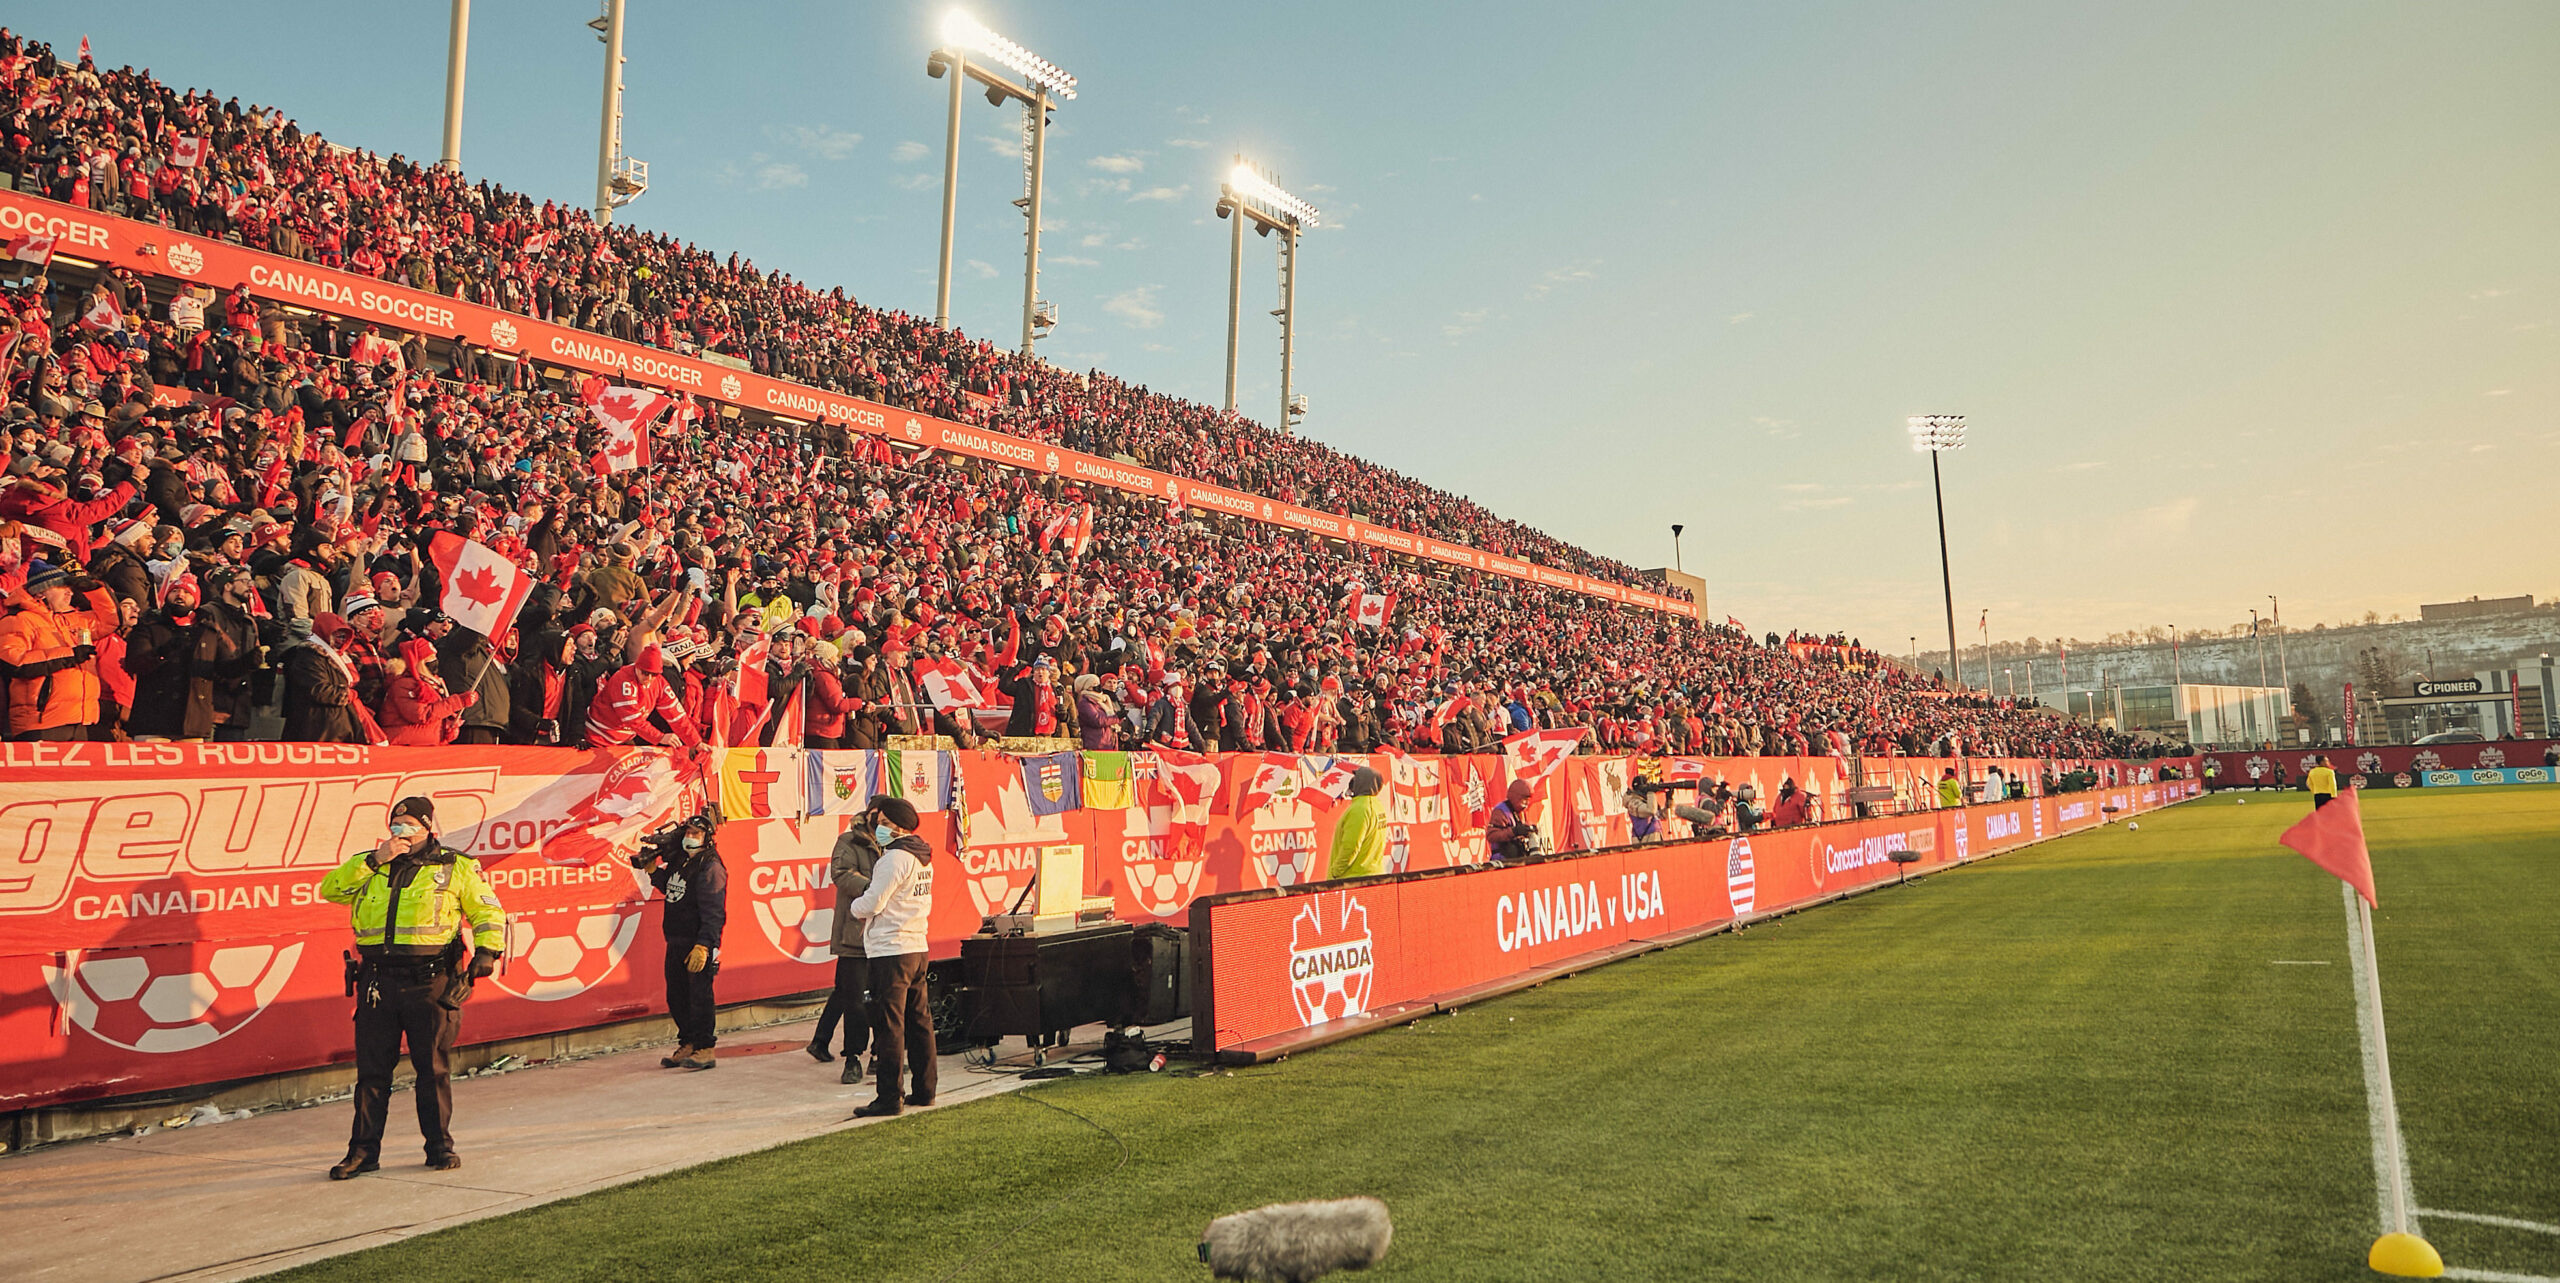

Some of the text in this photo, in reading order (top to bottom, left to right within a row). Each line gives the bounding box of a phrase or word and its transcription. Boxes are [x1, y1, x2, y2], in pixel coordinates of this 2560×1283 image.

[250, 265, 455, 330] CANADA SOCCER
[551, 336, 702, 387] CANADA SOCCER
[767, 388, 885, 429] CANADA SOCCER
[942, 428, 1035, 463] CANADA SOCCER
[1075, 460, 1153, 490] CANADA SOCCER
[1190, 487, 1255, 513] CANADA SOCCER
[1283, 510, 1339, 533] CANADA SOCCER
[1364, 528, 1412, 550] CANADA SOCCER
[2433, 681, 2477, 694] PIONEER
[0, 742, 91, 767] LEZ
[1251, 829, 1317, 853] CANADA
[1386, 825, 1411, 842] ADA
[964, 847, 1037, 876] CANA
[1826, 840, 1864, 874] Concacaf
[74, 885, 279, 921] CANADIAN
[1497, 870, 1665, 952] CANADA v USA
[1292, 945, 1371, 981] CANADA
